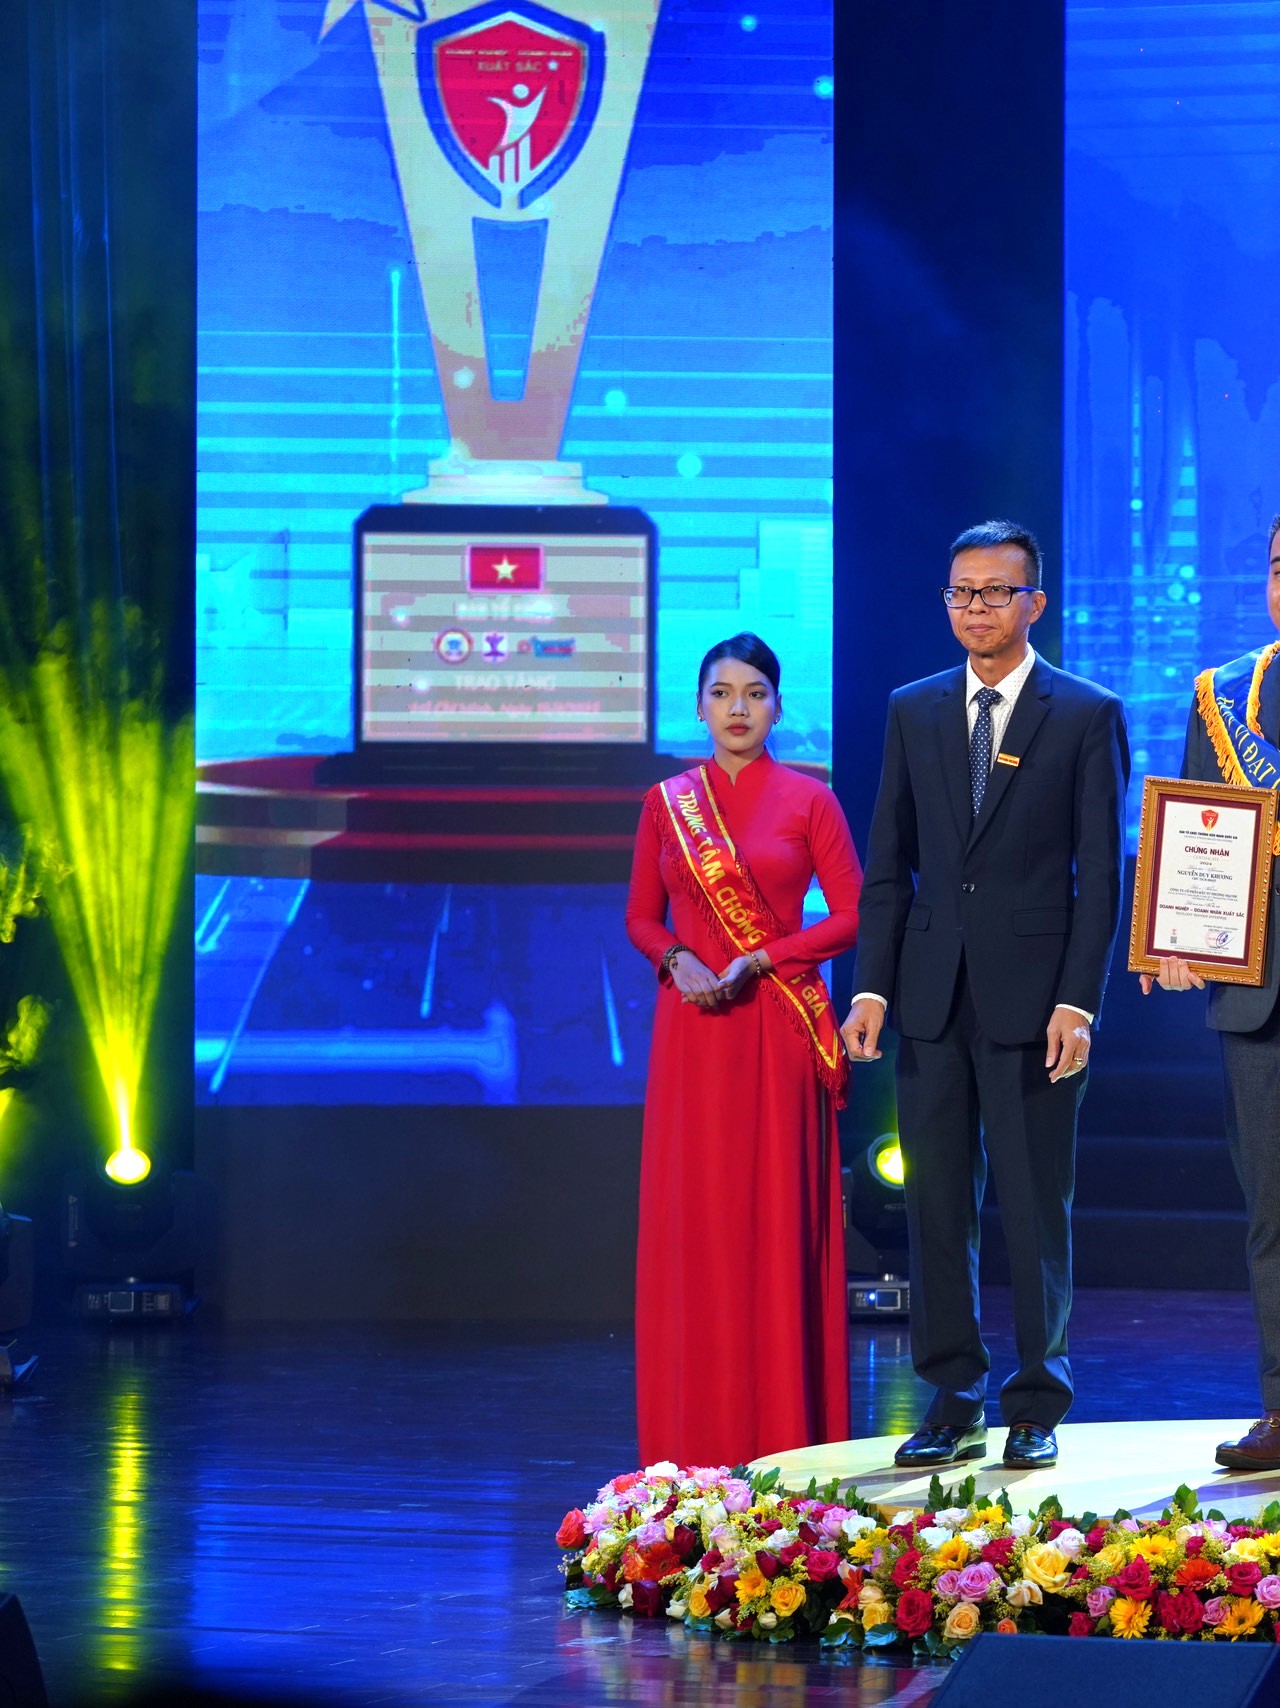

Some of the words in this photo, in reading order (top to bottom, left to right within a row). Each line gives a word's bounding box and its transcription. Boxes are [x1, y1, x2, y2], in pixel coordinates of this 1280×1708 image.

[1242, 741, 1277, 783] ĐẠT
[676, 789, 708, 838] TRUNG
[697, 836, 726, 885] TÂM
[716, 886, 768, 945] CHỐNG
[1184, 844, 1208, 855] CHỨNG
[1210, 847, 1230, 858] NHẬN
